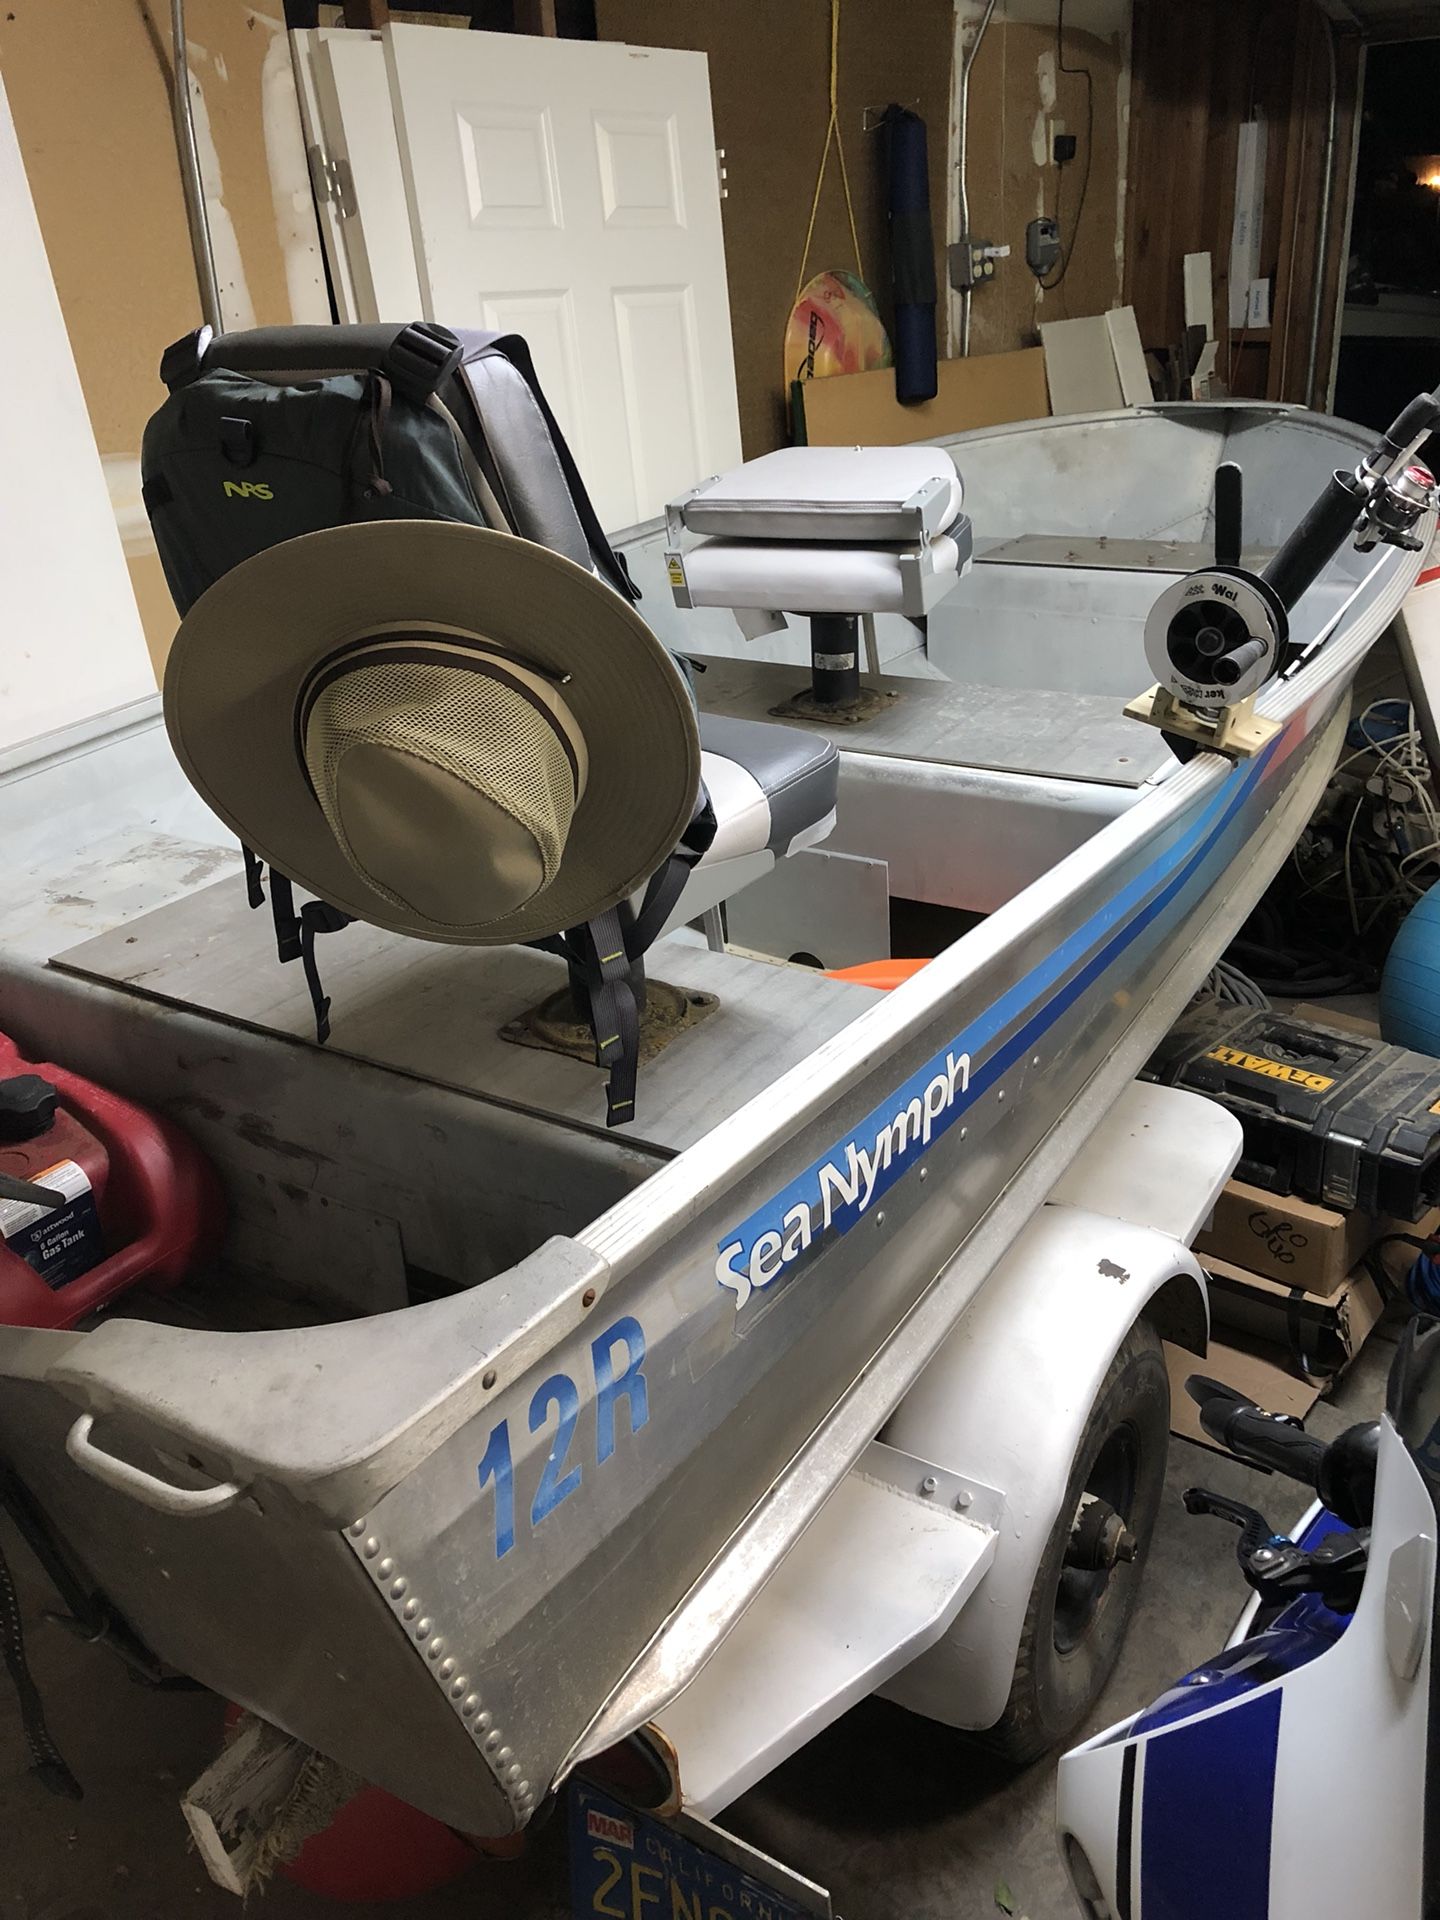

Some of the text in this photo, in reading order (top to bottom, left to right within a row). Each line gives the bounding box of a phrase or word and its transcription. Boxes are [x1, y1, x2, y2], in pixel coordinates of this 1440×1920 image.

[223, 481, 274, 500] NRS
[1206, 1046, 1336, 1093] DEWALT
[715, 1051, 971, 1312] Sea Nymph
[42, 1229, 85, 1260] Gas Tank
[46, 1230, 69, 1246] Gallon
[478, 1315, 650, 1560] 12R
[587, 1810, 633, 1845] MAR
[592, 1846, 732, 1920] 2FN
[645, 1836, 785, 1920] CALIFORNI
